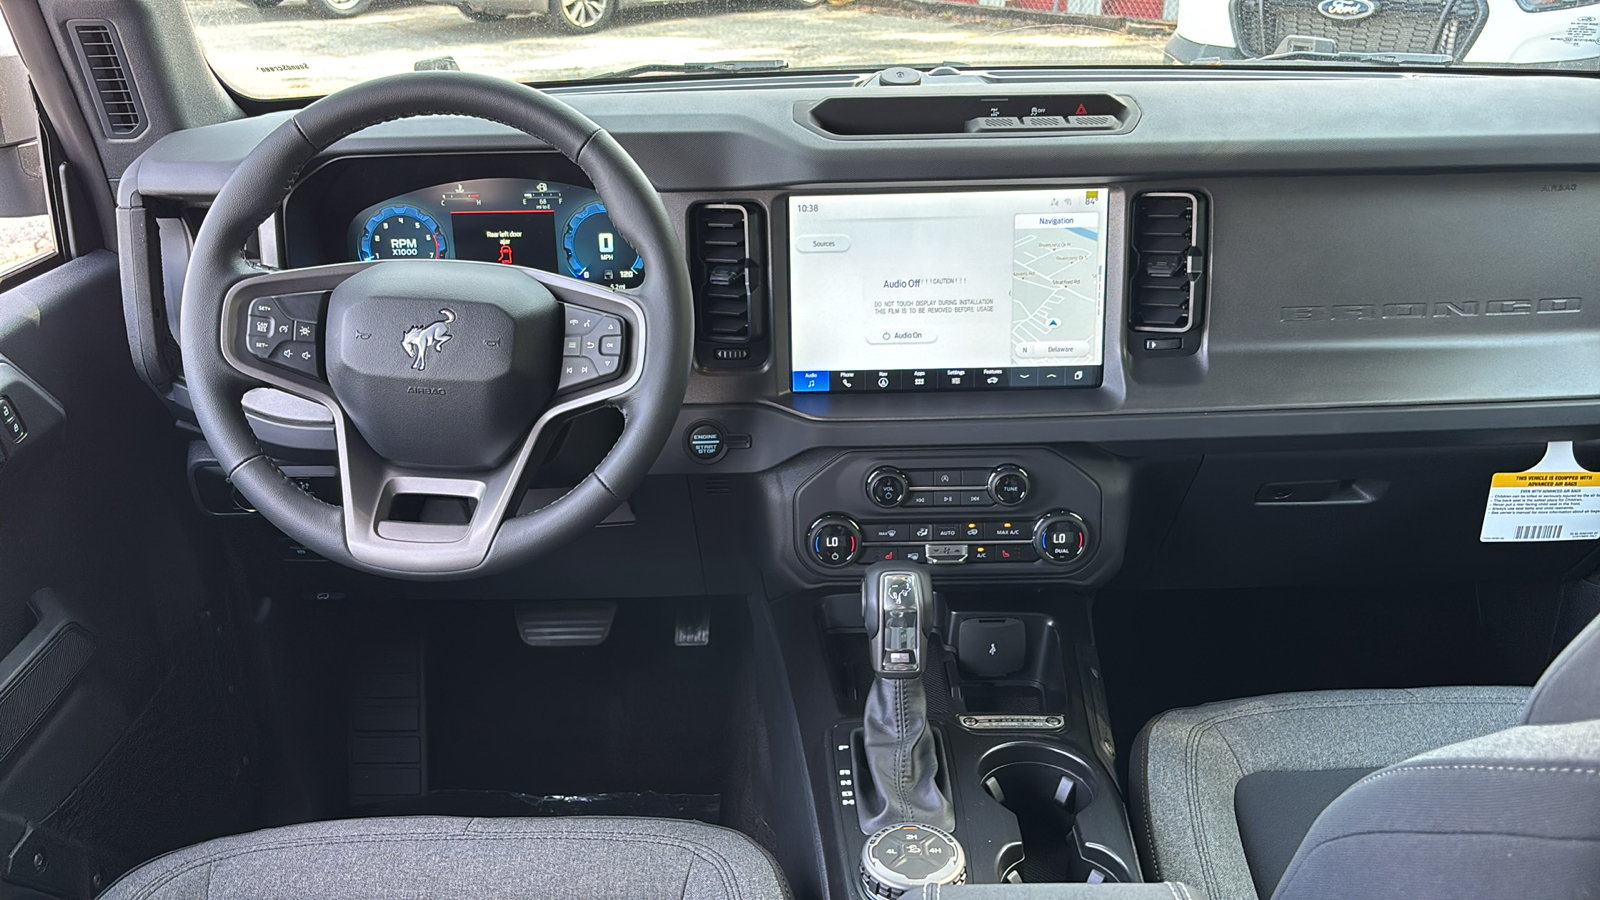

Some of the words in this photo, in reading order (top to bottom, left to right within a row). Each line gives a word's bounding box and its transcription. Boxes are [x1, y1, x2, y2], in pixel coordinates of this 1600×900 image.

[1328, 0, 1361, 14] Ford
[1540, 184, 1578, 192] AIRBAG
[798, 204, 818, 212] 10:38
[390, 238, 417, 248] RPM
[599, 233, 613, 252] 0
[883, 280, 907, 288] Audio
[908, 279, 921, 288] Off
[1280, 297, 1582, 322] BRONCO
[406, 386, 446, 396] AIRBAG
[826, 537, 838, 546] LO
[1053, 534, 1066, 544] LO
